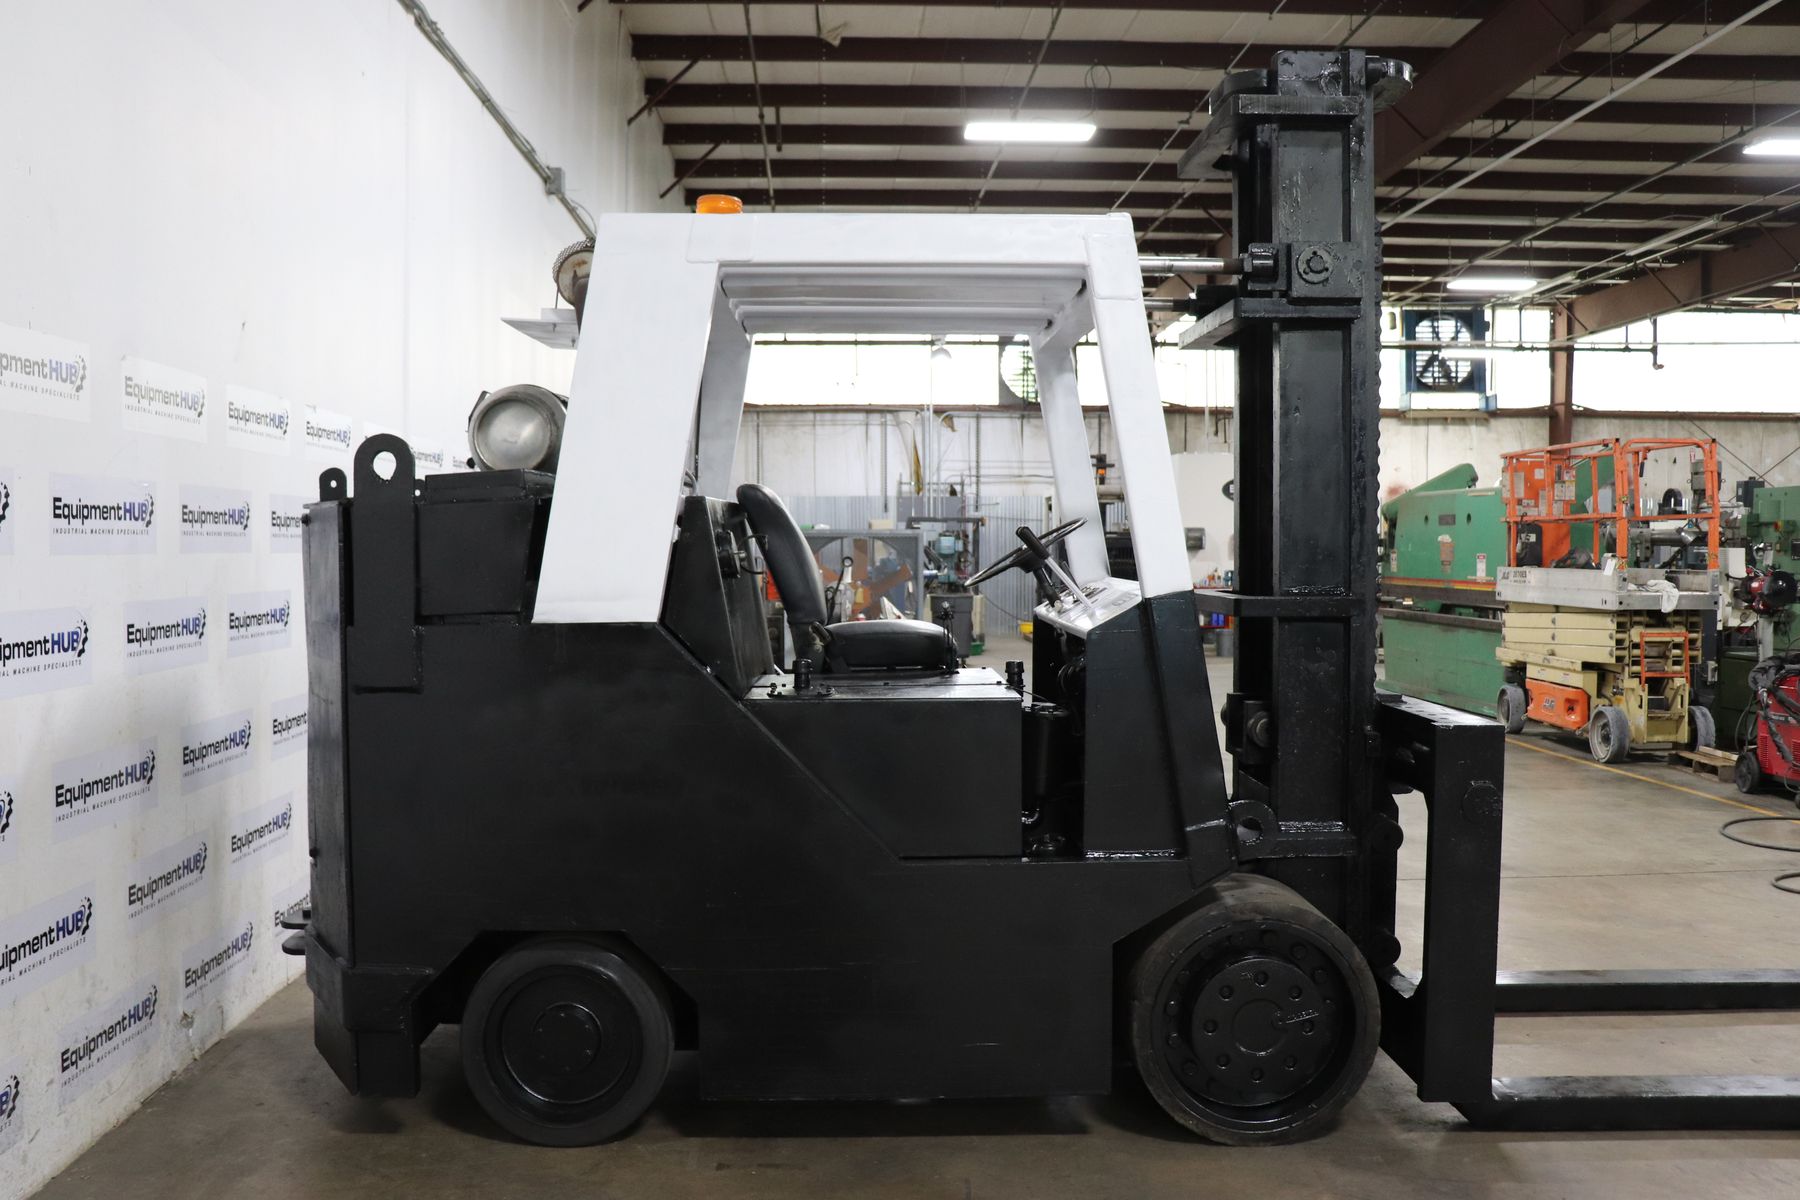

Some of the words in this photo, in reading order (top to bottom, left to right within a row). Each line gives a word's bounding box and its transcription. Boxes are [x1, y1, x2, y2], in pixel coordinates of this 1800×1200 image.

[124, 375, 199, 412] EquipmentHUB
[228, 401, 285, 430] EquipmentHUB
[306, 421, 348, 444] EquipmentHUB
[52, 496, 148, 525] EquipmentHUB
[181, 504, 245, 528] EquipmentHUB
[117, 528, 149, 536] SPECIALISTS
[126, 616, 201, 648] EquipmentHUB
[229, 607, 286, 632] EquipmentHUB
[13, 665, 41, 675] MACHINE
[43, 659, 82, 671] SPECIALISTS
[182, 728, 246, 767] EquipmentHUB
[55, 760, 149, 809] EquipmentHUB
[55, 806, 90, 823] INDUSTRIAL
[92, 799, 117, 811] MACHINE
[118, 787, 151, 802] SPECIALISTS
[231, 810, 288, 853] EquipmentHUB
[128, 851, 202, 906] EquipmentHUB
[19, 957, 46, 976] MACHINE
[49, 936, 86, 961] SPECIALISTS
[185, 931, 249, 988] EquipmentHUB
[61, 996, 151, 1073] EquipmentHUB
[61, 1061, 94, 1088] INDUSTRIAL
[97, 1044, 120, 1063] MACHINE
[122, 1022, 153, 1046] SPECIALISTS
